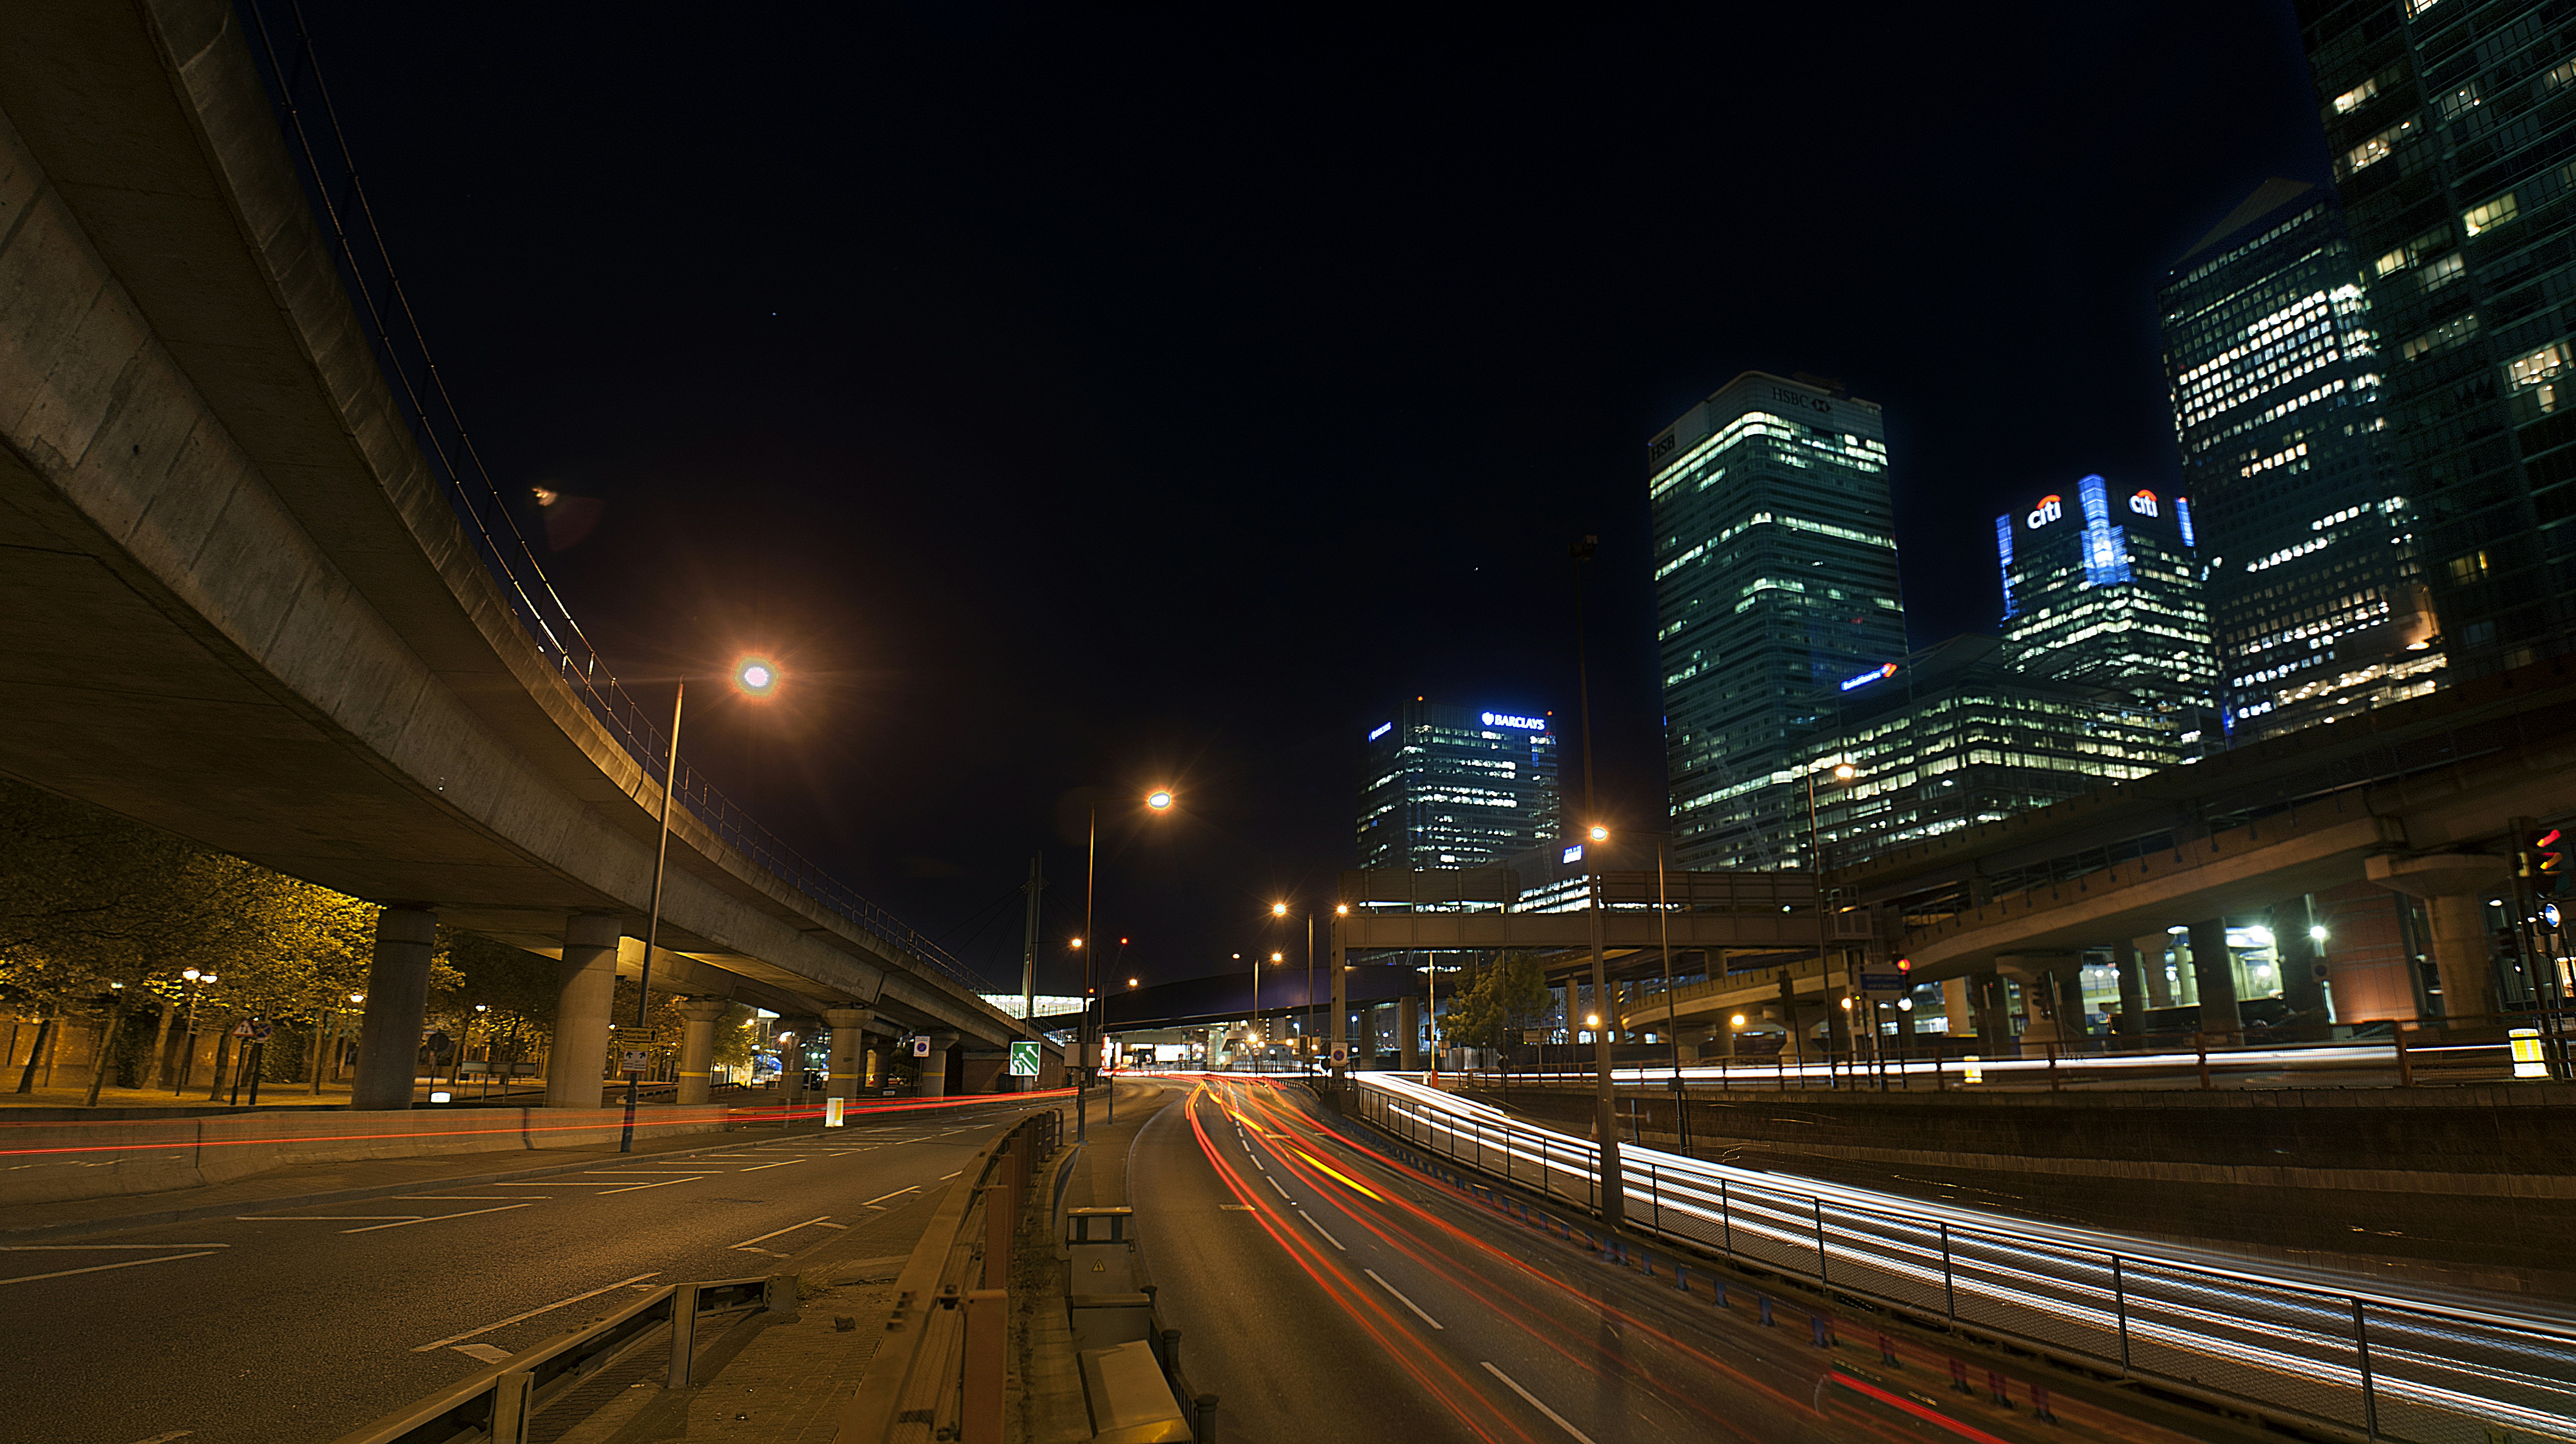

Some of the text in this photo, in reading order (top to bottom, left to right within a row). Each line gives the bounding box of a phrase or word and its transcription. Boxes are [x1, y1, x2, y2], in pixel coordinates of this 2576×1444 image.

[1772, 387, 1809, 408] HSBC
[2027, 494, 2062, 529] citi
[2128, 489, 2159, 518] citi
[1495, 714, 1545, 730] BARCLAYS
